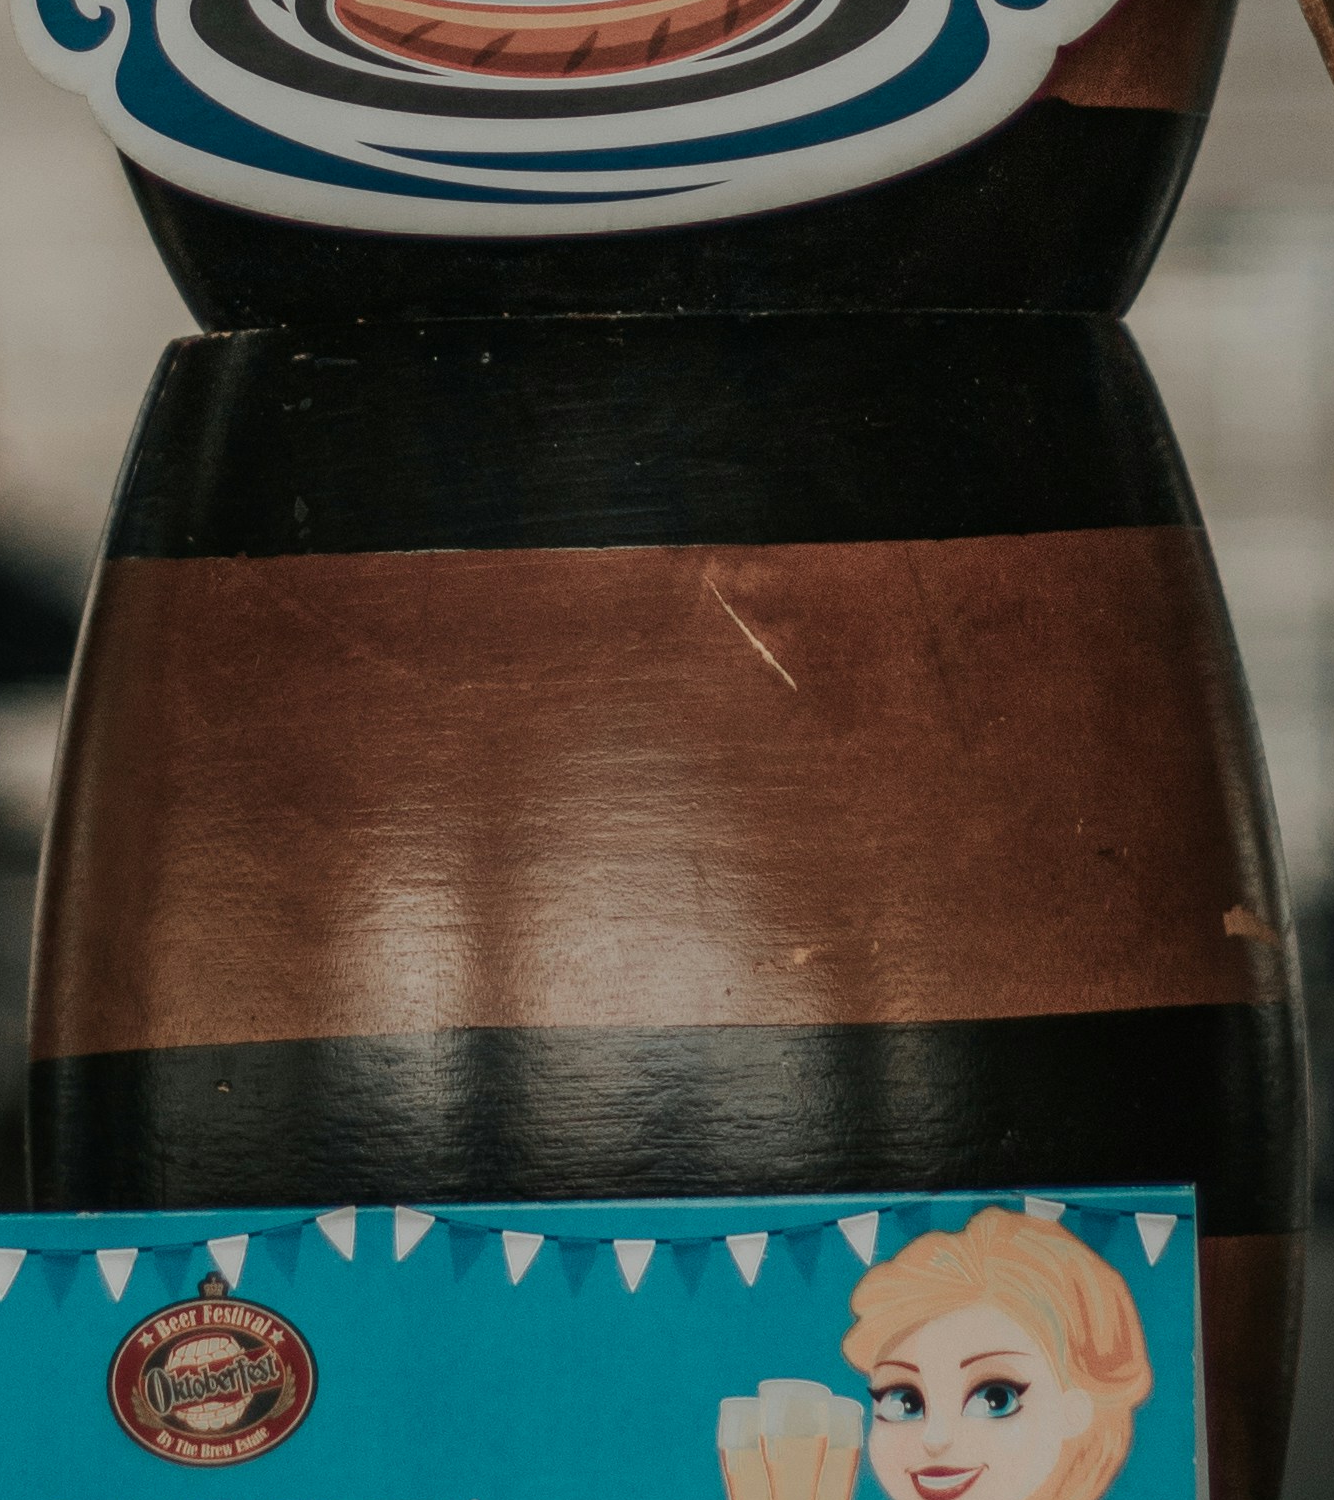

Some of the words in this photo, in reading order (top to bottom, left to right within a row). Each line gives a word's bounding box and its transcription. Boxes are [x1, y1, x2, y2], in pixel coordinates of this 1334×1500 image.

[154, 1308, 197, 1339] Beer
[203, 1304, 272, 1336] Festival
[145, 1349, 280, 1416] Oktoberfest
[156, 1429, 172, 1449] By
[176, 1439, 198, 1457] The
[200, 1443, 233, 1459] Brew
[235, 1426, 270, 1454] Estate
